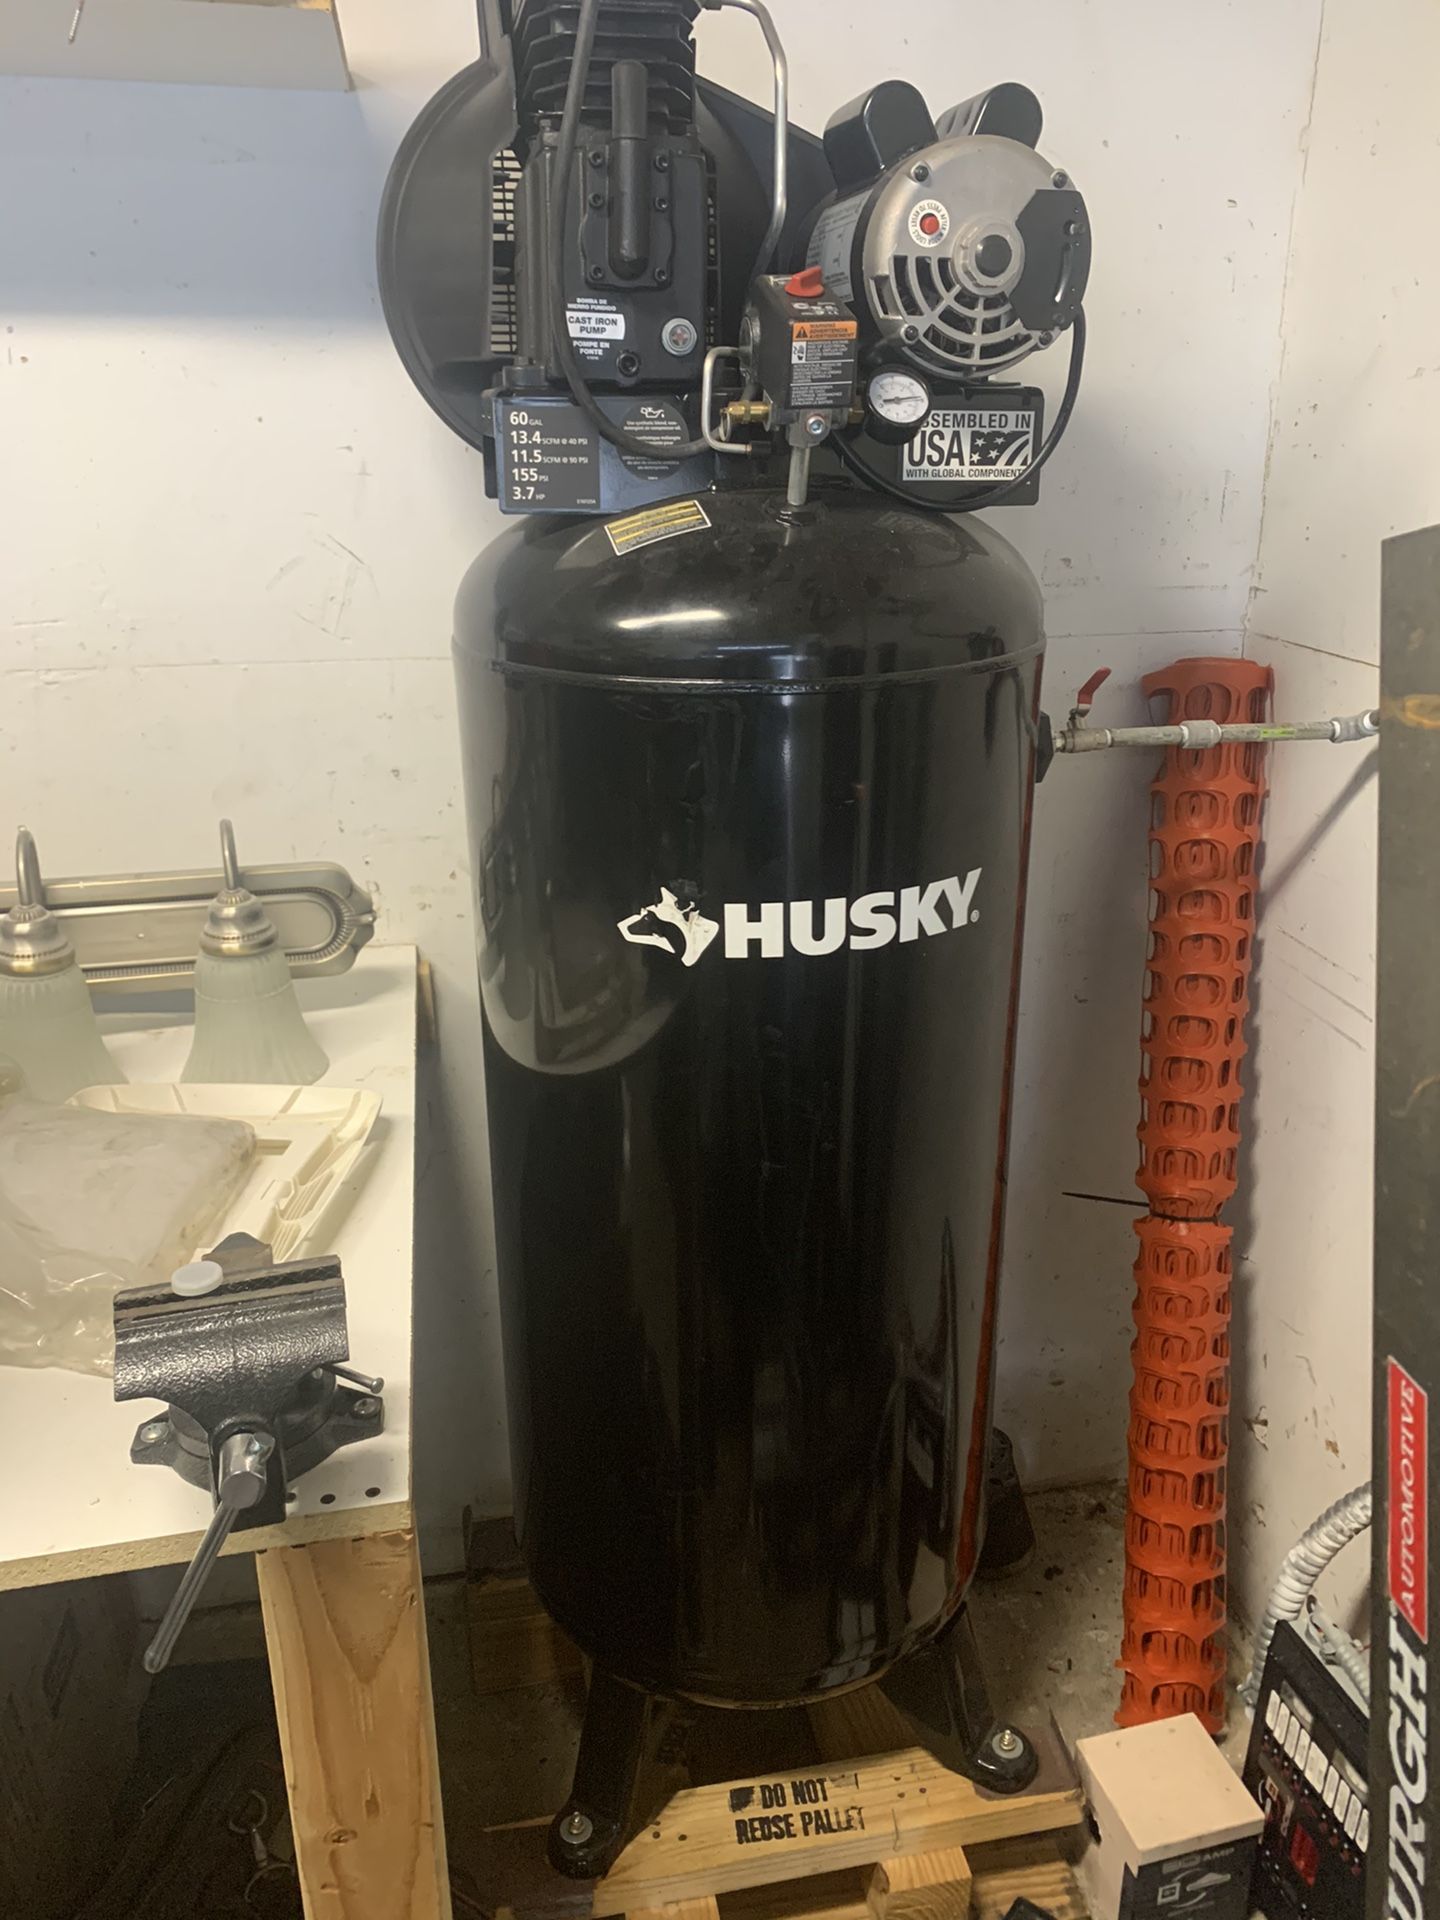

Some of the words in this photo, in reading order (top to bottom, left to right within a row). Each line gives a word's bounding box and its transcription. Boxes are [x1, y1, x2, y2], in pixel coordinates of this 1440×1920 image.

[568, 315, 592, 325] CAST
[595, 317, 618, 326] IRON
[580, 325, 607, 335] PUMP
[573, 340, 598, 348] POMPE
[599, 341, 610, 349] EN
[579, 347, 603, 356] FONTE
[510, 411, 529, 426] 60
[528, 418, 543, 426] GAL
[922, 413, 1009, 429] SEMBLED
[1015, 414, 1031, 429] IN
[510, 430, 541, 445] 13.4
[578, 437, 588, 445] PSI
[908, 429, 965, 467] USA
[511, 449, 543, 463] 11.5
[578, 456, 589, 464] PSI
[511, 468, 539, 482] 155
[906, 468, 930, 478] WITH
[931, 468, 966, 478] GLOBAL
[512, 486, 535, 500] 3.7
[724, 868, 982, 959] HUSKY
[1401, 1379, 1415, 1620] AUTOMOTIVE
[760, 1783, 787, 1809] DO
[791, 1777, 829, 1805] NOT
[735, 1813, 797, 1844] REUSE
